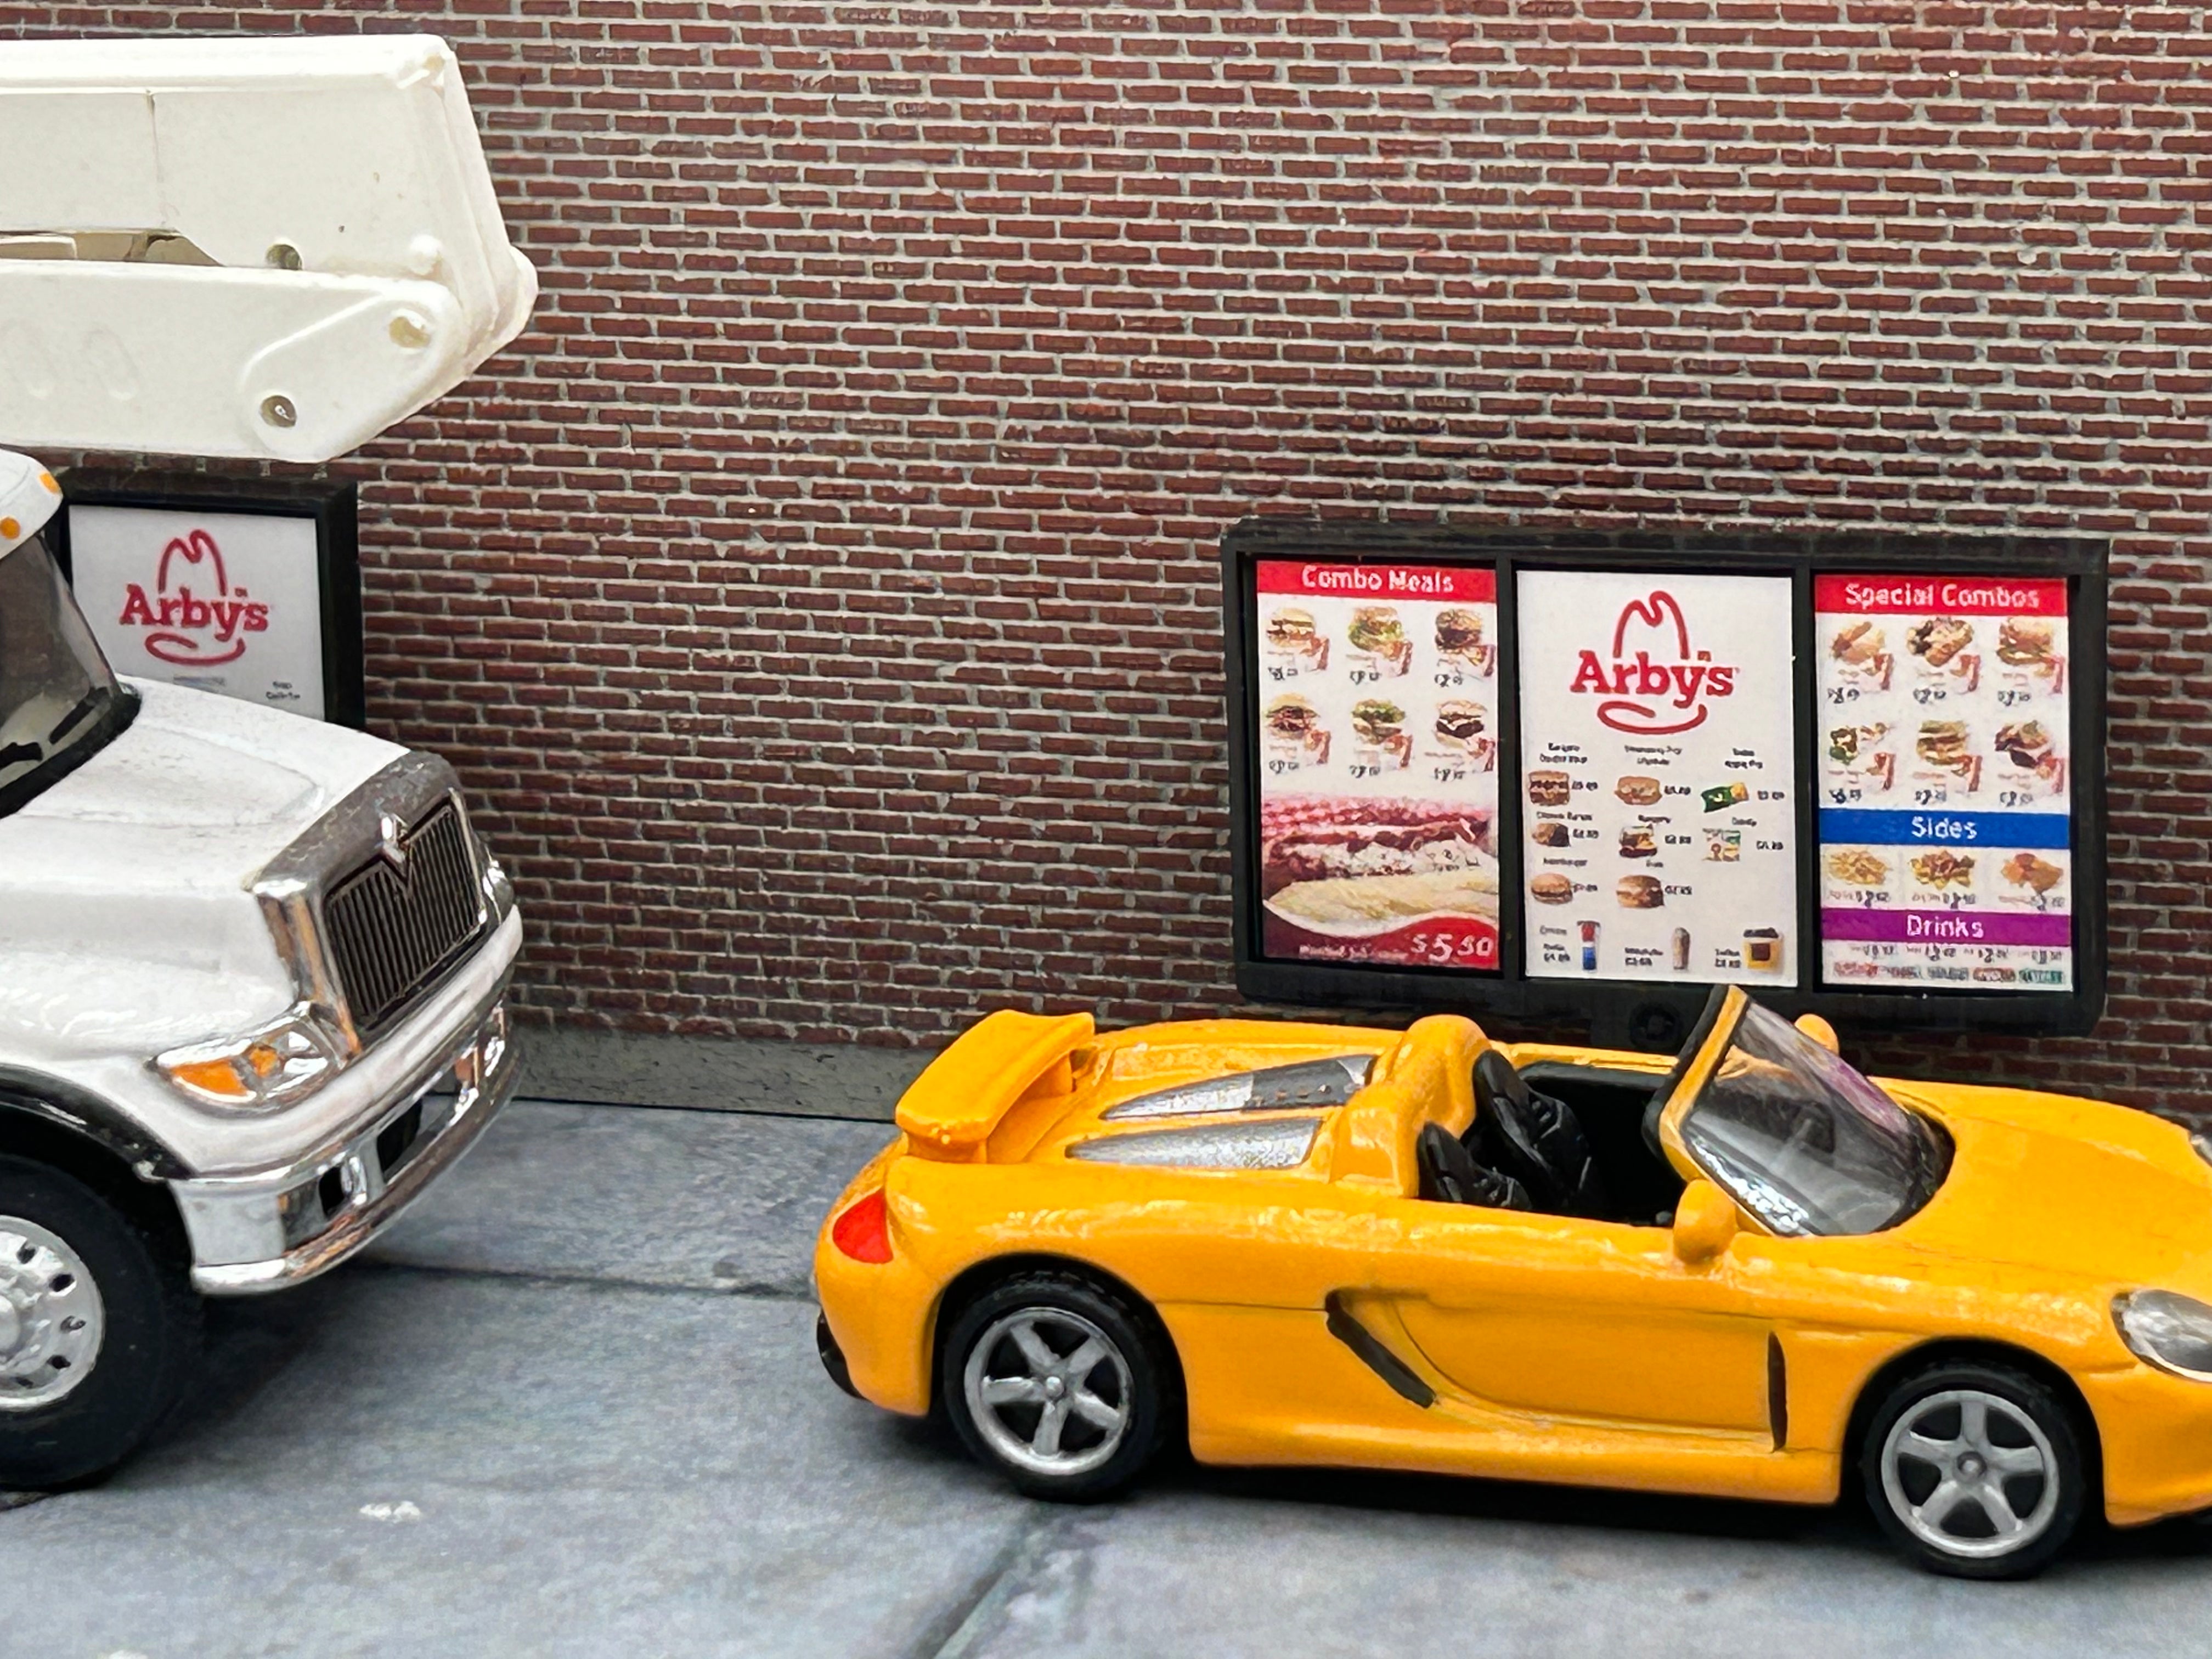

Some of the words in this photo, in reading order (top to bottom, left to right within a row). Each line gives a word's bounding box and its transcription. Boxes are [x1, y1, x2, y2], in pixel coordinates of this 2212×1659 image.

[1302, 565, 1382, 590] Combo
[1389, 569, 1454, 593] Meals
[1845, 583, 1934, 610] Special
[1941, 583, 2040, 608] Combos
[119, 583, 269, 642] Arby's
[1570, 650, 1735, 709] Arby's
[1911, 816, 1977, 840] Sides
[1906, 914, 1984, 939] Drinks
